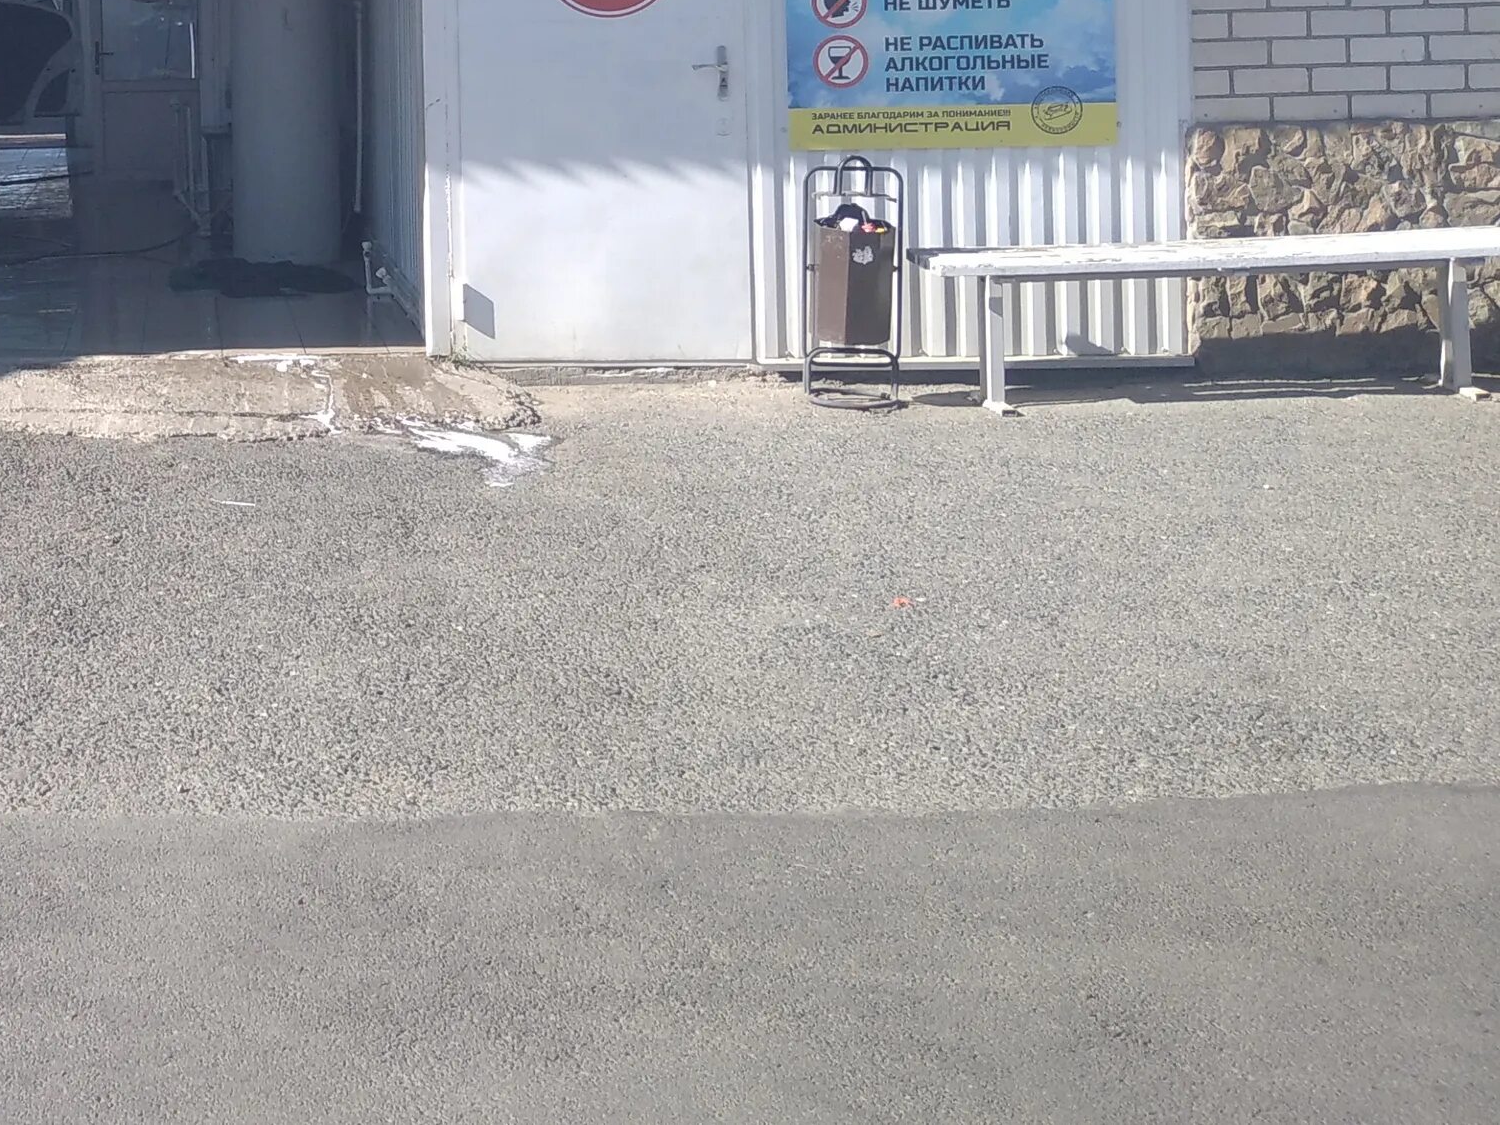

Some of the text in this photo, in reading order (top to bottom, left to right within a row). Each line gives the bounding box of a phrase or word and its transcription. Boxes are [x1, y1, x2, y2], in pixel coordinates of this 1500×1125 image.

[884, 33, 1043, 52] НЕ РАСПИВАТЬ
[884, 53, 1049, 72] АЛКОГОЛЬНЫЕ
[885, 75, 985, 92] НАПИТКИ
[811, 108, 1011, 120] ЗАРАНЕЕ БЛАГОДАРИМ ЗА ПОНИМАНИЕ!!!
[811, 120, 1010, 134] АДМИНИСТРАЦИЯ
